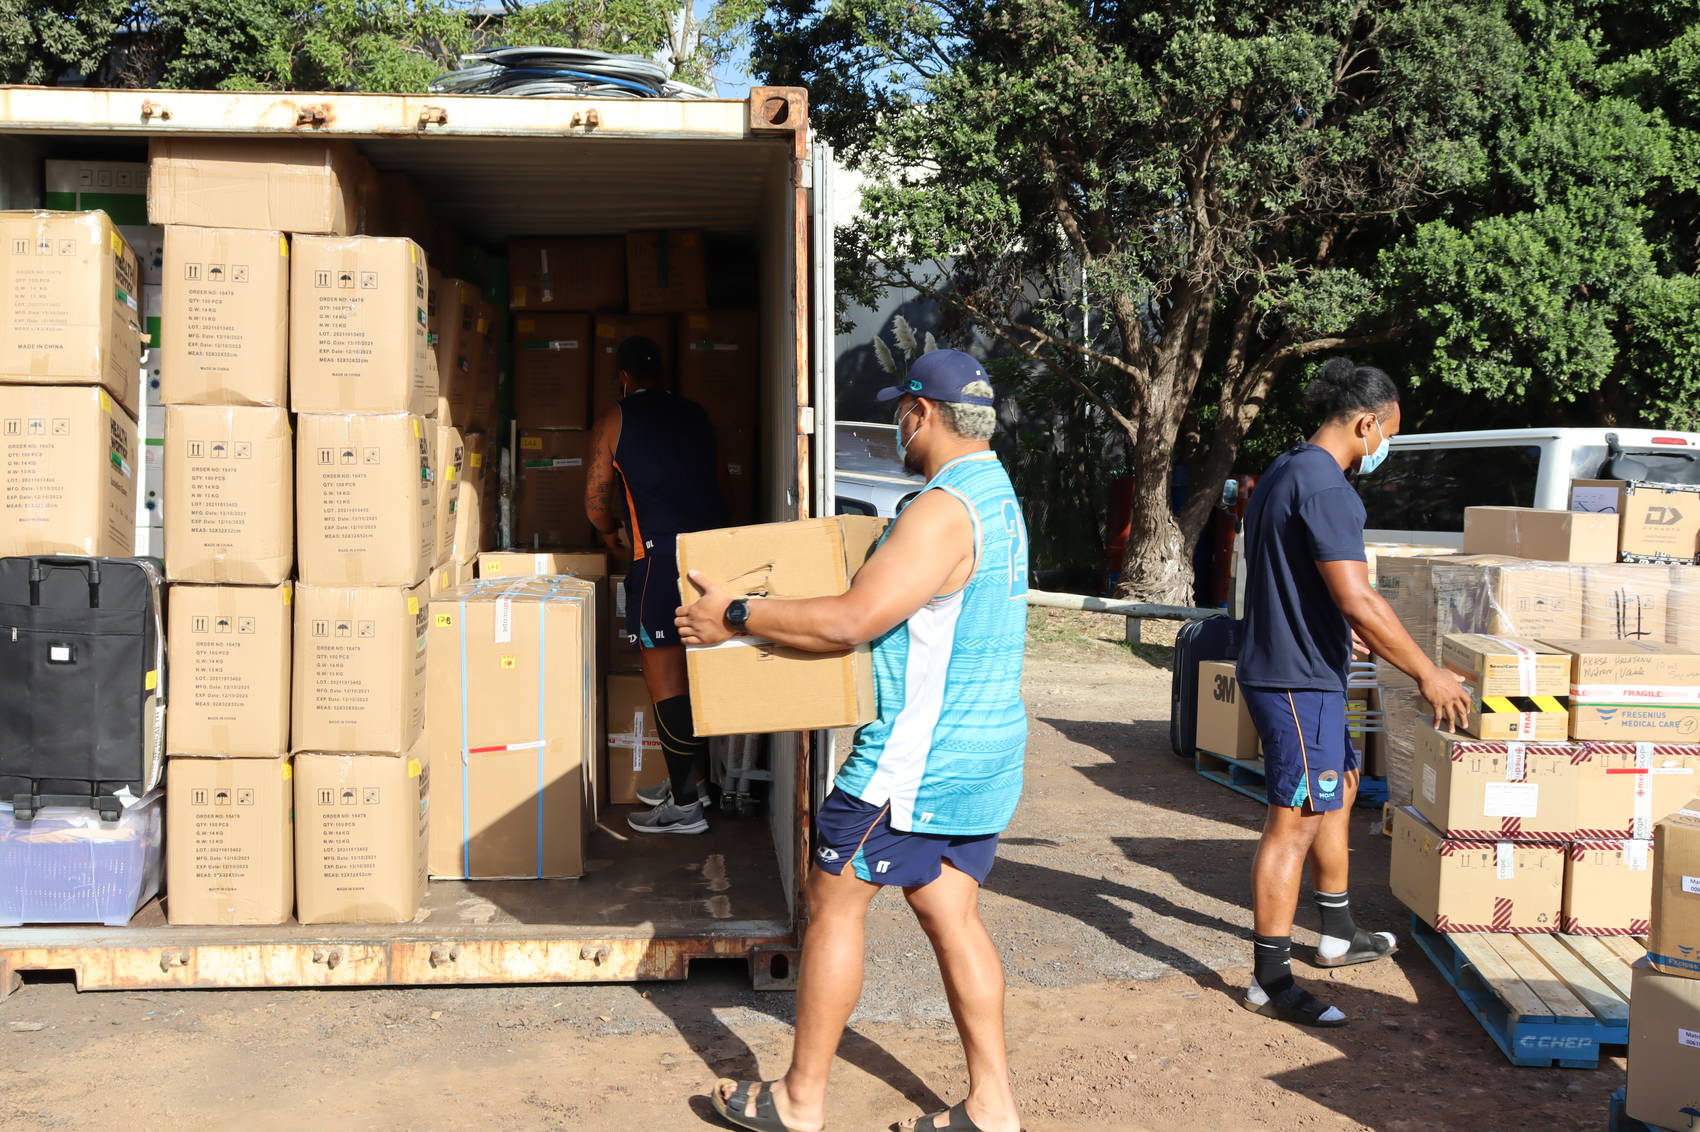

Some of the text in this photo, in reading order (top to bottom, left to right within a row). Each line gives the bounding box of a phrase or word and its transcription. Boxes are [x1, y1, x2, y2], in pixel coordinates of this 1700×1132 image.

[655, 630, 665, 639] DL
[1213, 673, 1236, 704] 3M
[1622, 690, 1662, 698] FRAGILE
[1621, 711, 1667, 719] FRESENIUS
[1621, 720, 1657, 728] MEDICAL
[1537, 1035, 1592, 1049] CHEP
